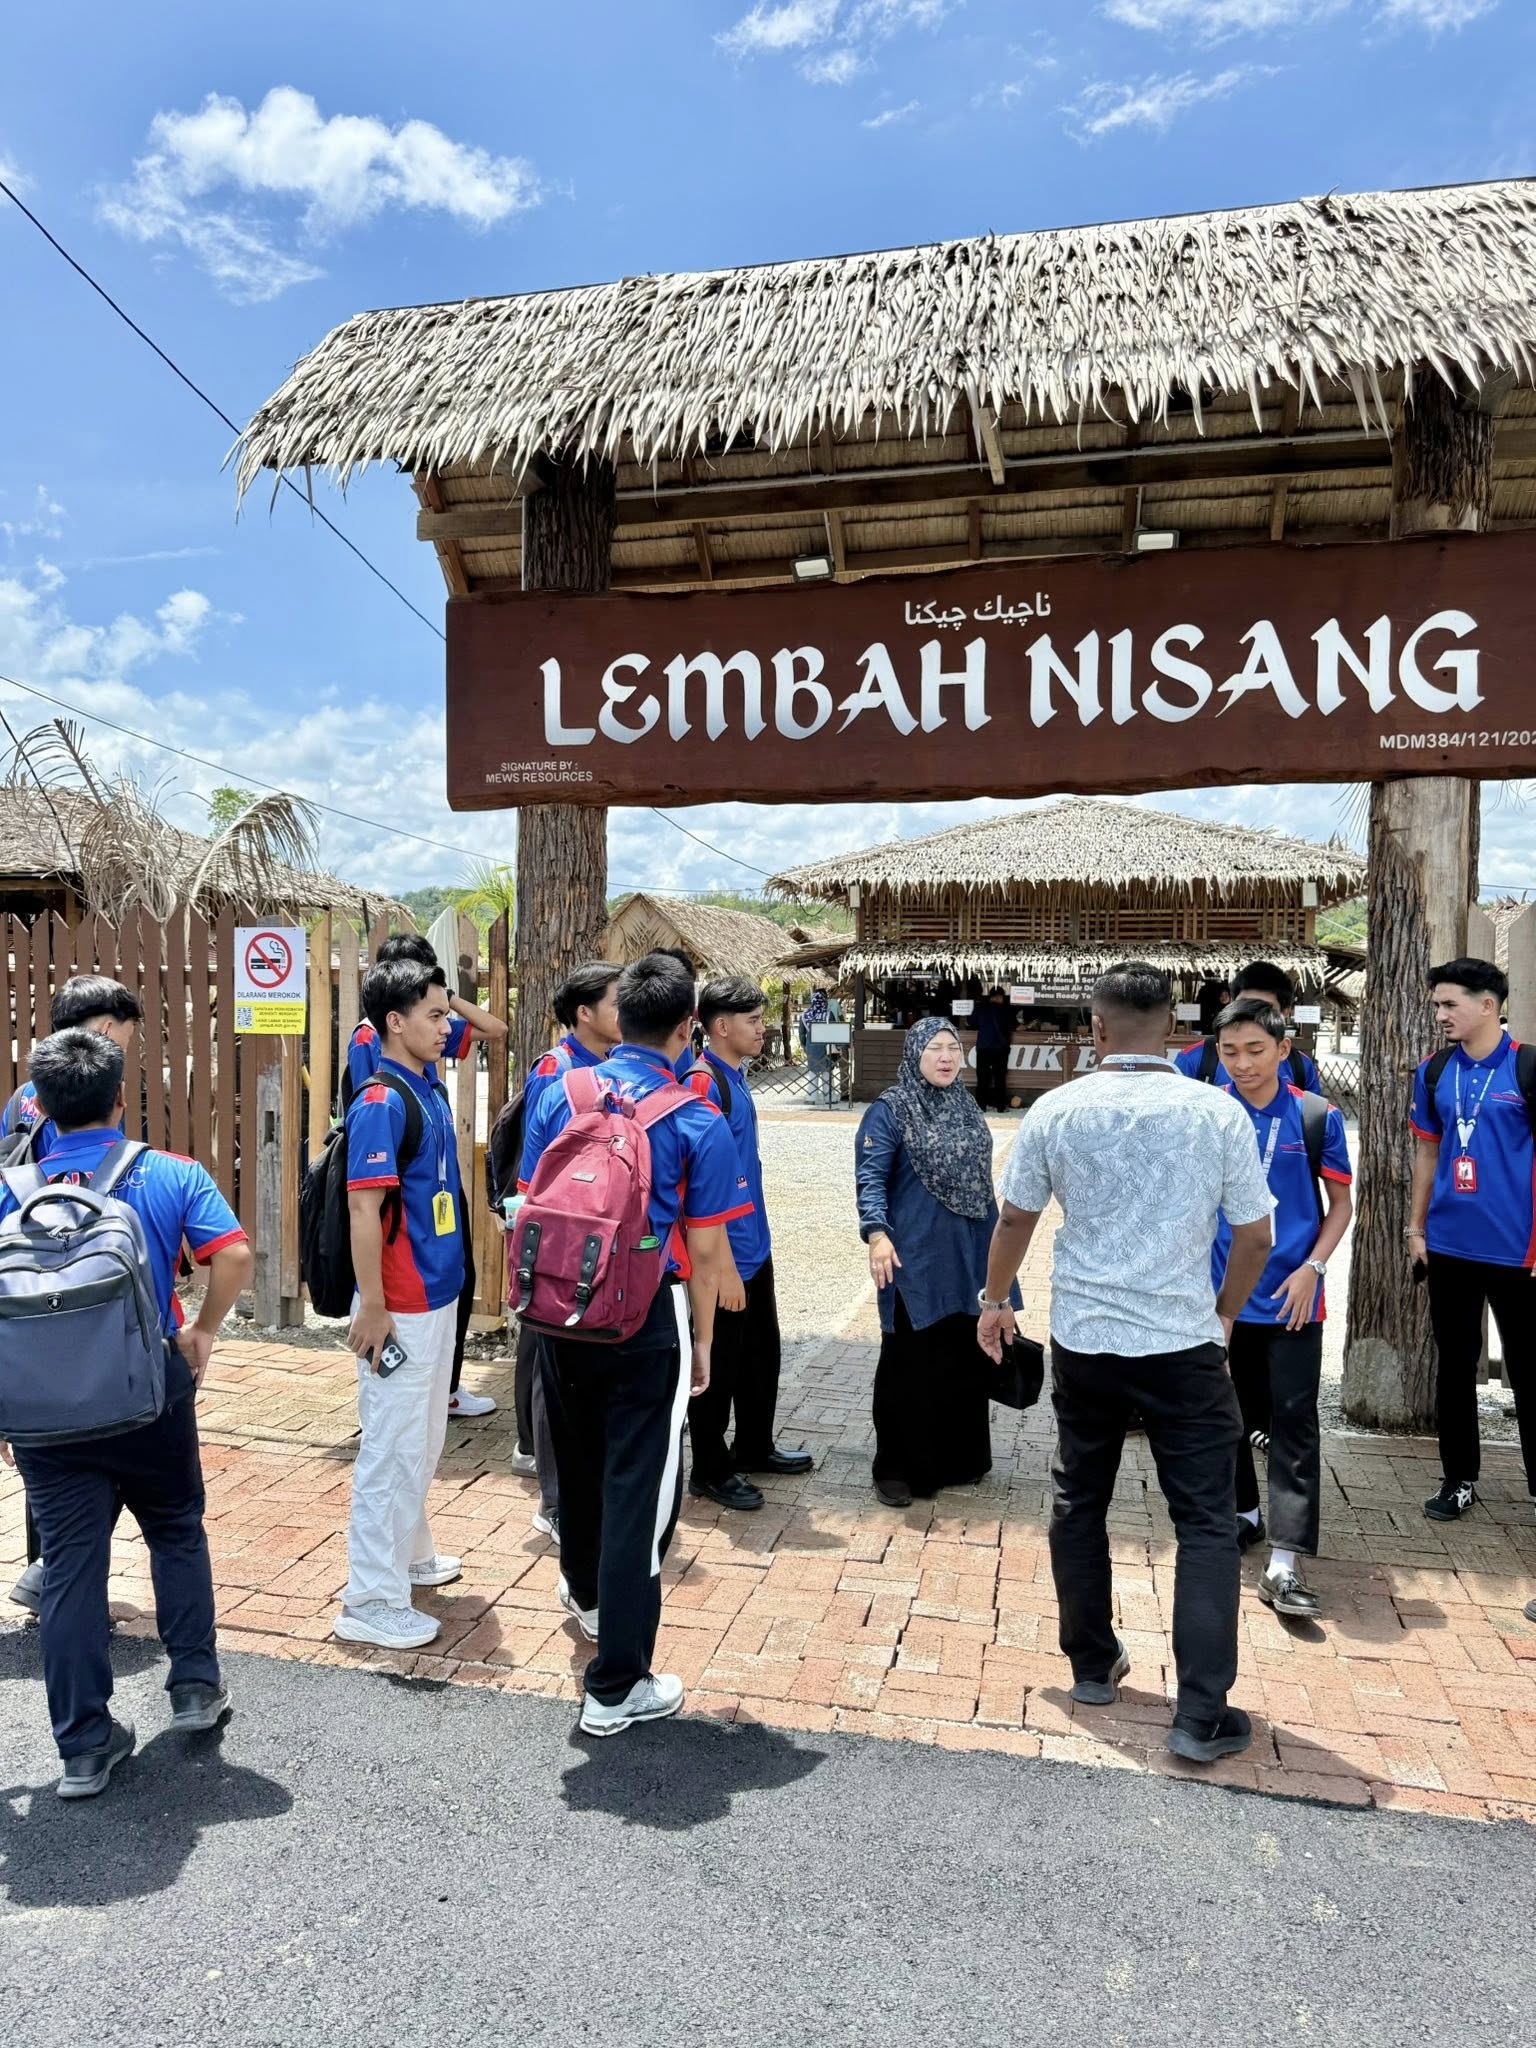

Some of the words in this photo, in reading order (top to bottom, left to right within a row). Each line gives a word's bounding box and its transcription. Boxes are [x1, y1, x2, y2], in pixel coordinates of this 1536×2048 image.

[539, 636, 992, 746] LEMBAH
[1024, 609, 1486, 729] NISANG
[500, 761, 557, 772] SIGNATURE
[559, 760, 573, 771] BY
[485, 772, 520, 784] MEWS
[522, 771, 593, 783] RESOURCES
[237, 991, 267, 999] DILARANG
[267, 991, 301, 999] MEROKOK
